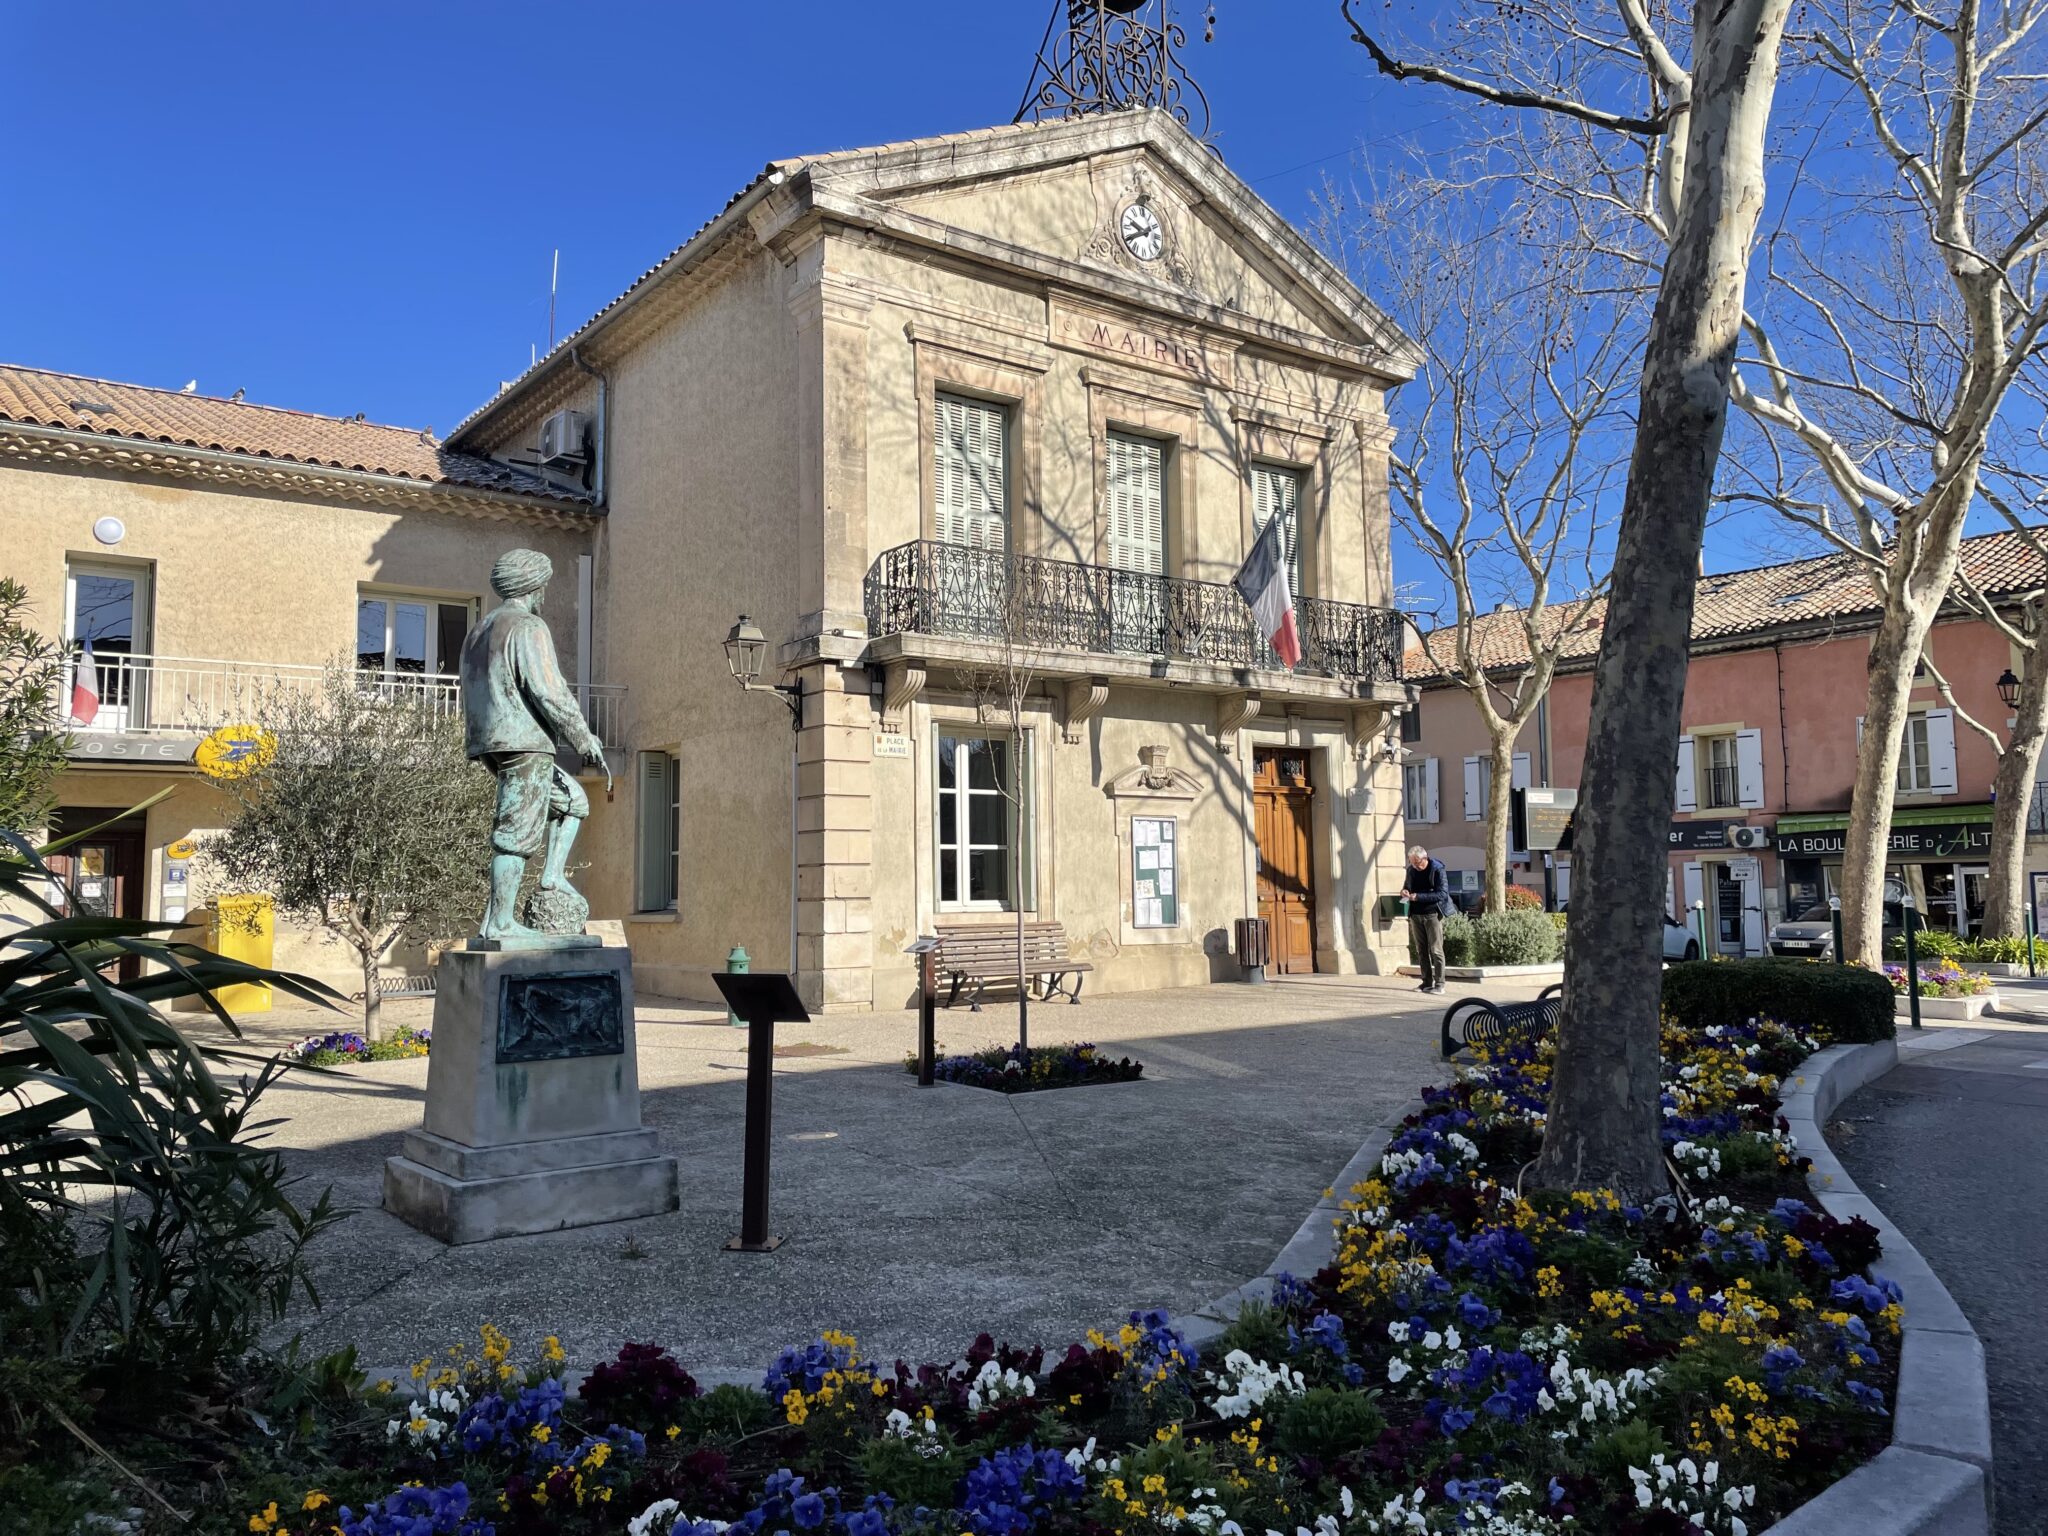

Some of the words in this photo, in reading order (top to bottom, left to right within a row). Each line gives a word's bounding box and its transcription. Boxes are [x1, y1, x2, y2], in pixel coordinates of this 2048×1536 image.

[1092, 323, 1199, 369] MAIRIE
[886, 737, 905, 745] PLACE
[86, 742, 176, 756] OSTE
[1669, 831, 1684, 842] er
[1779, 839, 1798, 853] LA
